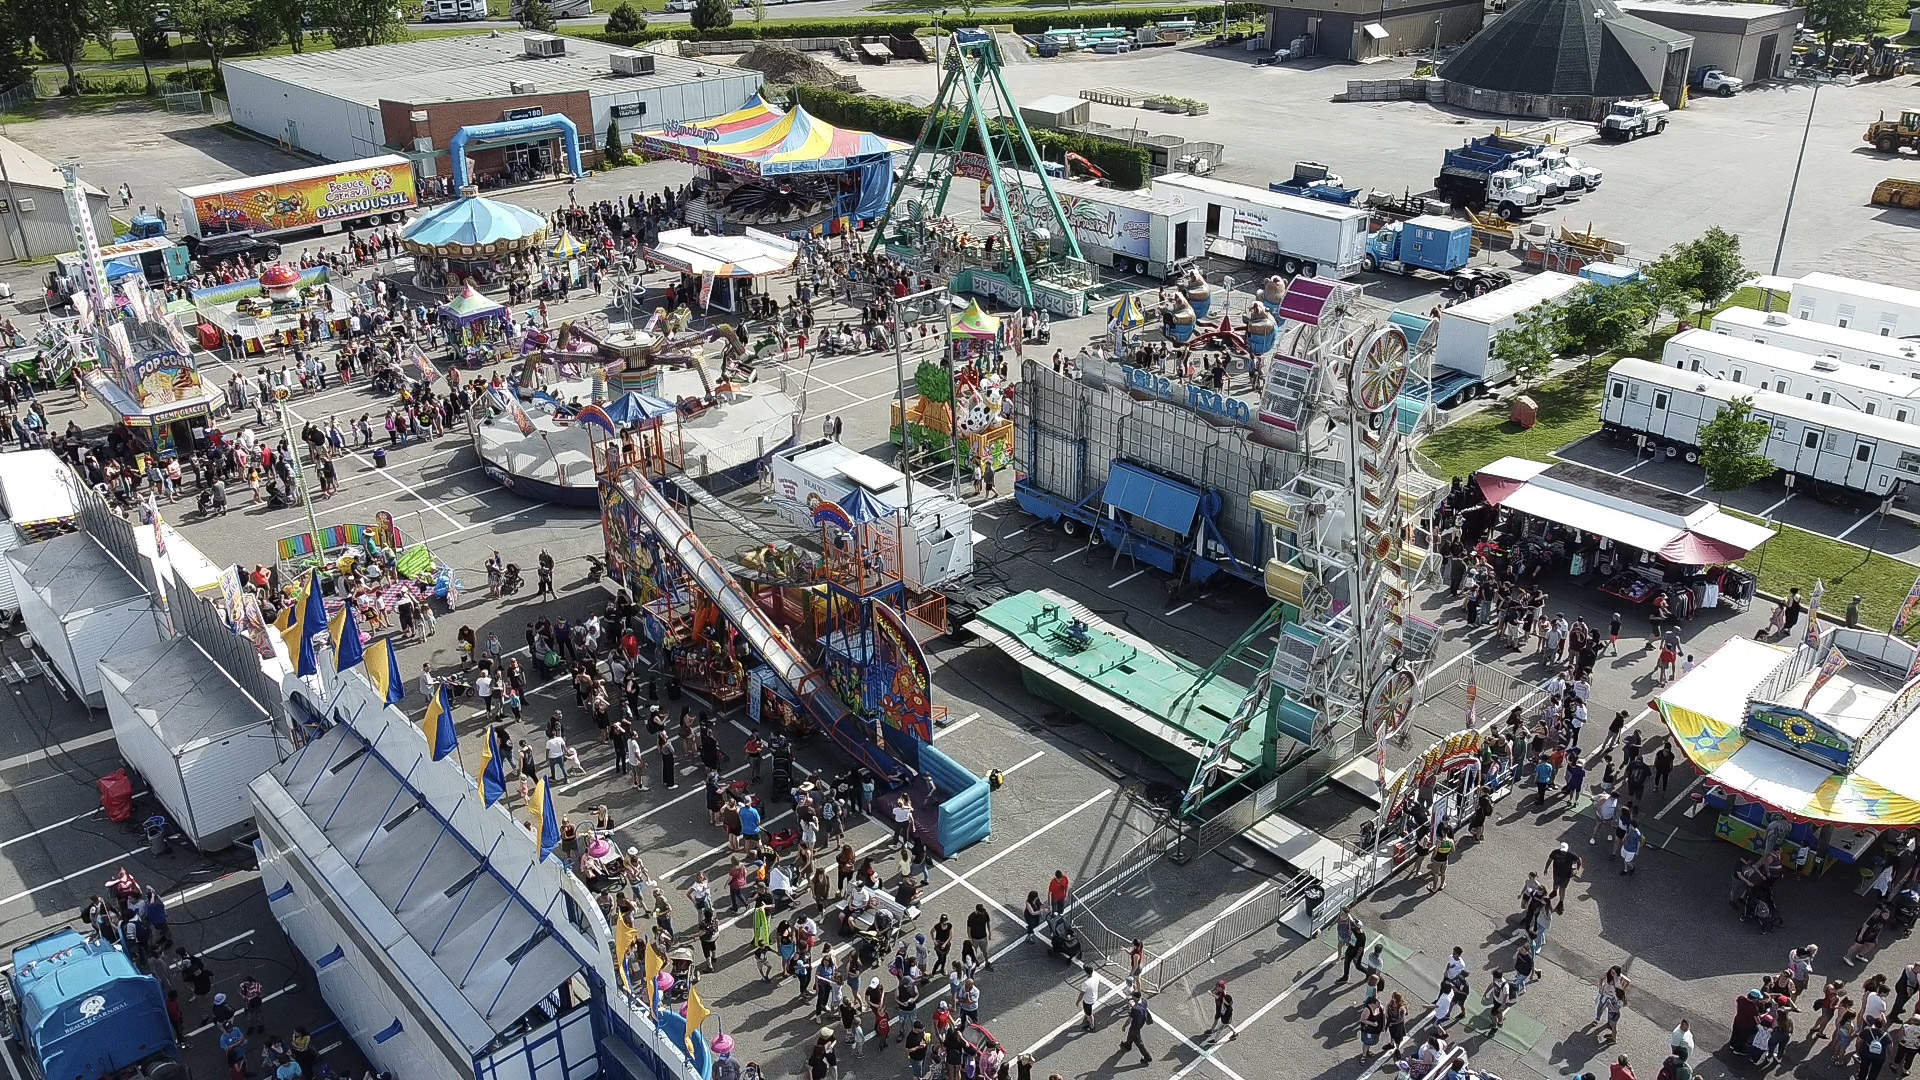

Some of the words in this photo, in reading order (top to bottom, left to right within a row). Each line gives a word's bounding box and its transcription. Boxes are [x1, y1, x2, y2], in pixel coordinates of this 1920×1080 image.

[325, 187, 371, 203] Carnaval
[328, 179, 365, 194] Beauce
[316, 192, 409, 218] CARROUSEL
[139, 360, 161, 379] POP
[161, 355, 194, 369] CORN
[65, 1019, 92, 1033] BEAUCE
[92, 1002, 128, 1021] CARNAVAL
